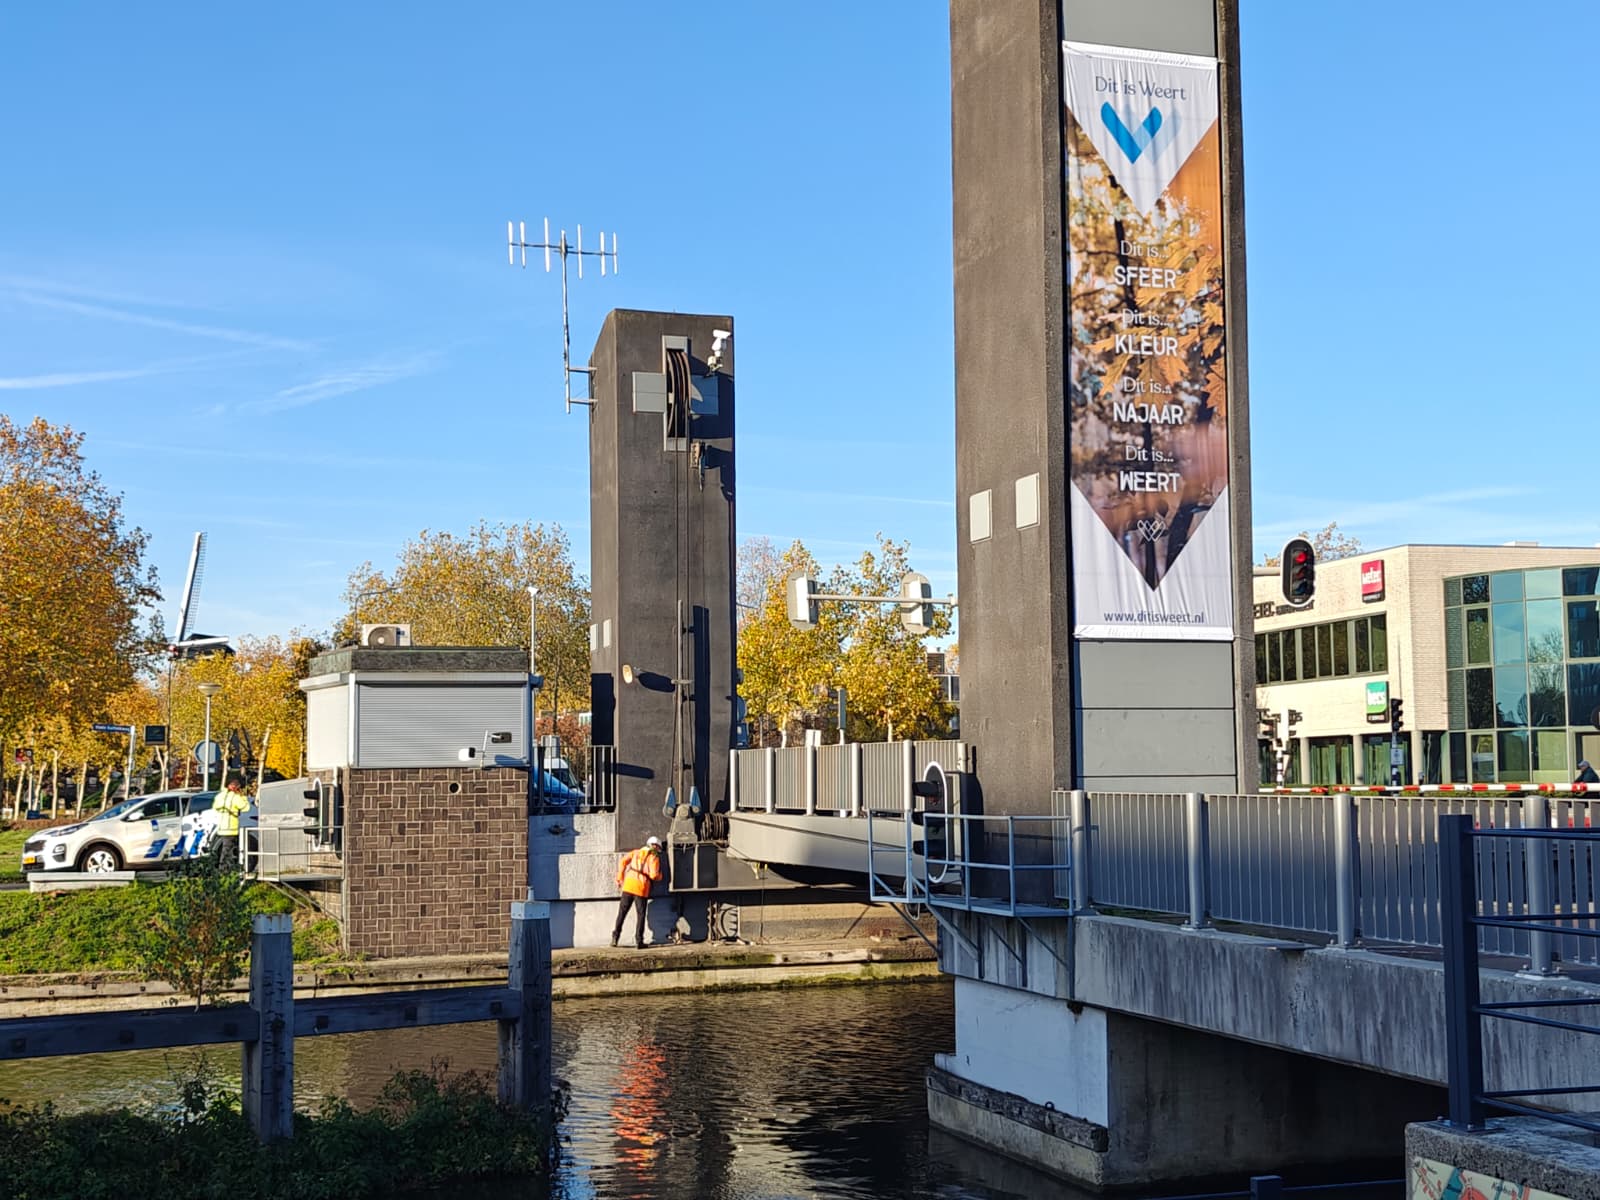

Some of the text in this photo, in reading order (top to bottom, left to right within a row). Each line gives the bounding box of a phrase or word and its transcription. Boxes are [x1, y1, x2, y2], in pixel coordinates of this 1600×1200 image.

[1095, 76, 1187, 100] Dit is Weert
[1120, 240, 1144, 257] Dit
[1114, 265, 1177, 289] SFEER
[1122, 308, 1145, 325] Dit
[1115, 334, 1178, 357] KLEUR
[1123, 376, 1146, 393] Dit
[1113, 402, 1184, 425] NAJAAR
[1125, 445, 1148, 461] Dit
[1119, 470, 1180, 493] WEERT
[1103, 610, 1205, 624] www.ditisweert.nl
